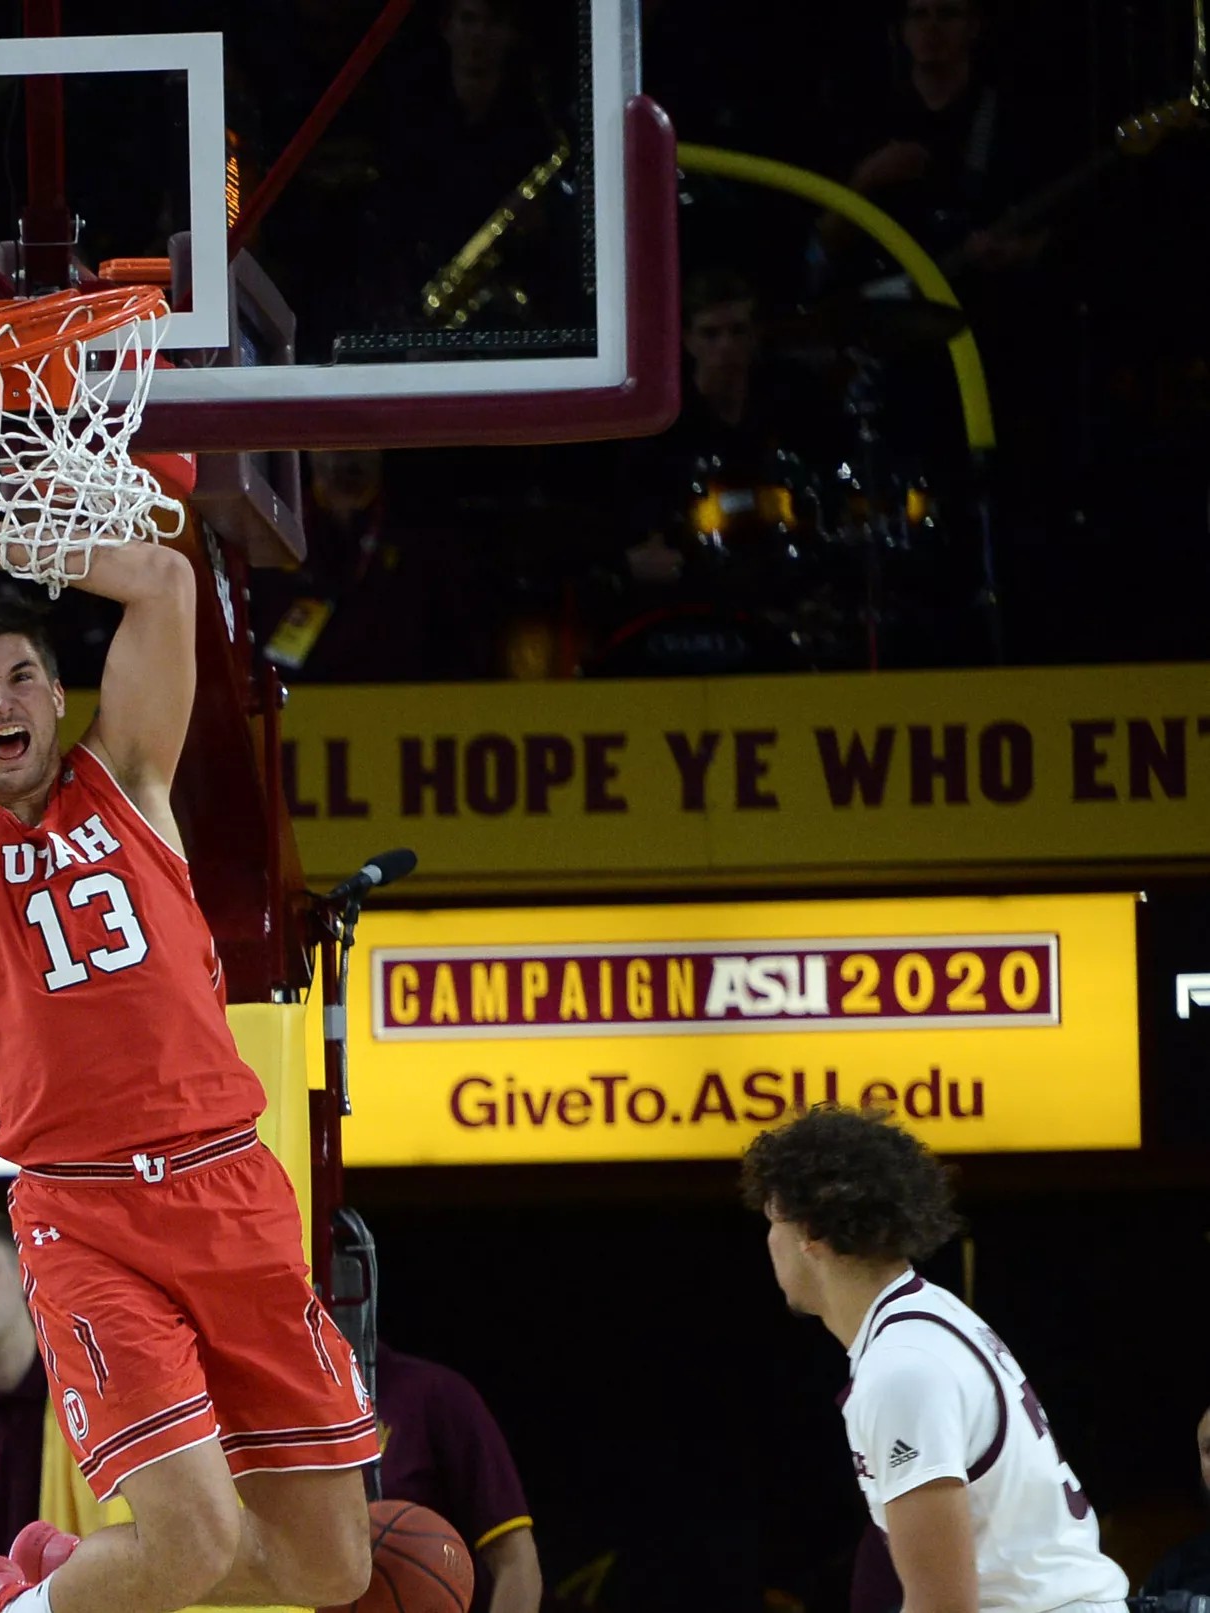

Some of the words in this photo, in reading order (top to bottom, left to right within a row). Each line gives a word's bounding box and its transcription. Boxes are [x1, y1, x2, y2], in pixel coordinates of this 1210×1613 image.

[282, 737, 370, 819] LL
[399, 732, 628, 818] HOPE
[663, 729, 780, 812] YE
[812, 720, 1033, 810] WHO
[1, 813, 122, 884] UTAH
[25, 871, 150, 992] 13
[389, 957, 696, 1026] CAMPAIGN
[703, 953, 830, 1018] ASU
[839, 950, 1041, 1015] 2020
[449, 1065, 985, 1129] GiveTo.ASUedu
